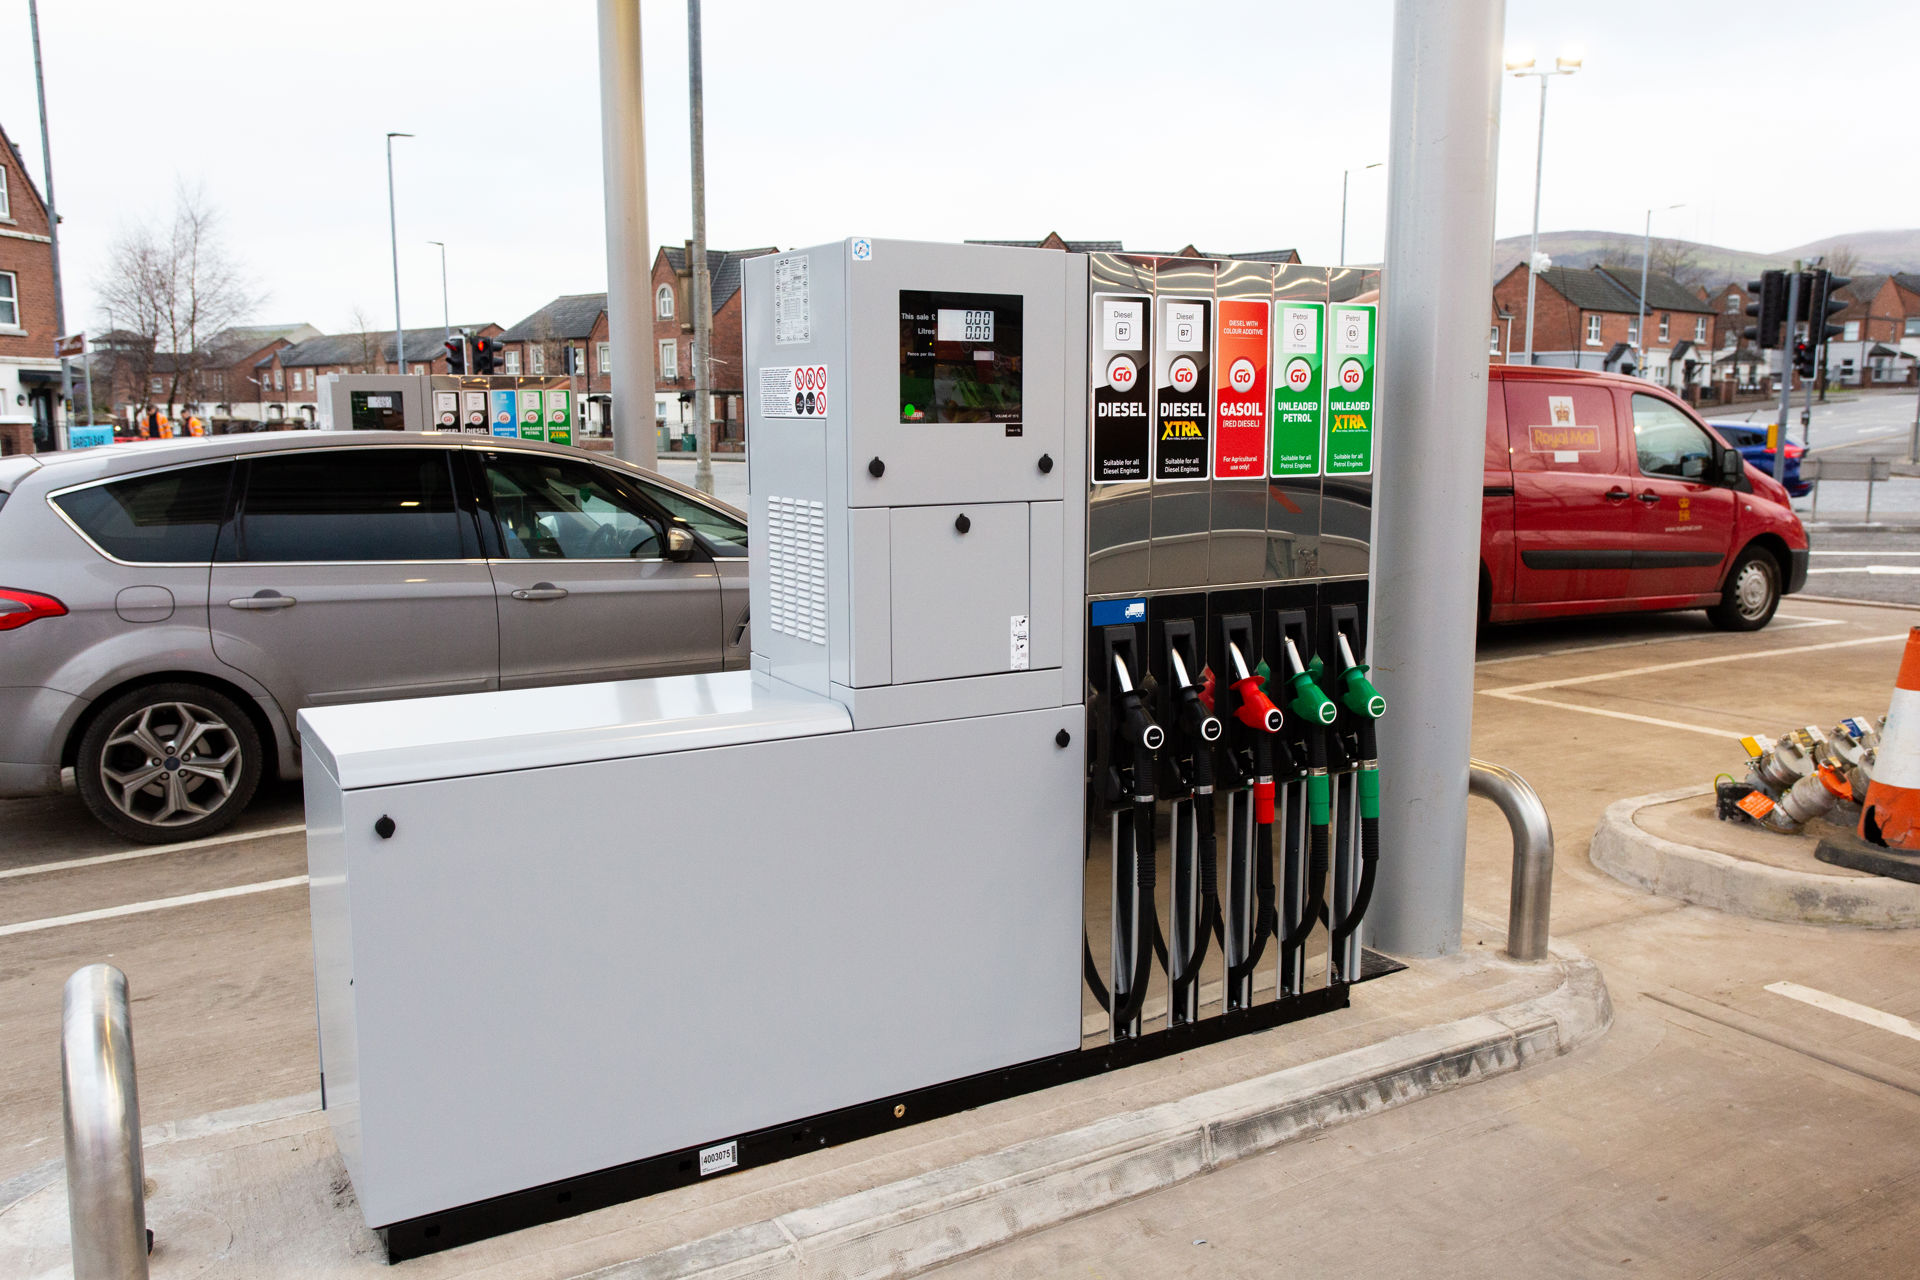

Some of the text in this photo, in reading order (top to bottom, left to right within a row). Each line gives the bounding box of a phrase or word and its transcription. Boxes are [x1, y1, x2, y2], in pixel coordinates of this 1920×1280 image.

[1113, 310, 1133, 319] Diesel
[1176, 312, 1194, 320] Diesel
[1292, 312, 1309, 321] Petrol
[1345, 314, 1361, 322] Petrol
[1228, 319, 1259, 328] DIESEL WITH
[1118, 327, 1128, 335] B7
[1180, 329, 1189, 337] B7
[1223, 327, 1264, 336] COLOUR ADDITIVE
[1296, 328, 1304, 336] E5
[1348, 329, 1357, 337] E5
[1098, 402, 1147, 417] DIESEL
[1160, 402, 1206, 417] DIESEL
[1219, 402, 1263, 417] GASOIL
[1277, 401, 1318, 411] UNLEADED
[1330, 401, 1370, 411] UNLEADED
[1283, 413, 1312, 423] PETROL
[1222, 419, 1260, 428] (RED DIESEL)
[1331, 414, 1367, 433] XTRA
[1161, 420, 1203, 440] XTRA
[1534, 429, 1595, 448] Royal Mail
[1231, 455, 1258, 463] Agricultural
[1239, 463, 1250, 472] only!
[1294, 462, 1312, 470] Engines
[1347, 460, 1364, 468] Engines
[1103, 467, 1140, 475] Diesel Engines
[1180, 466, 1200, 474] Engines
[703, 1149, 731, 1164] 4003075
